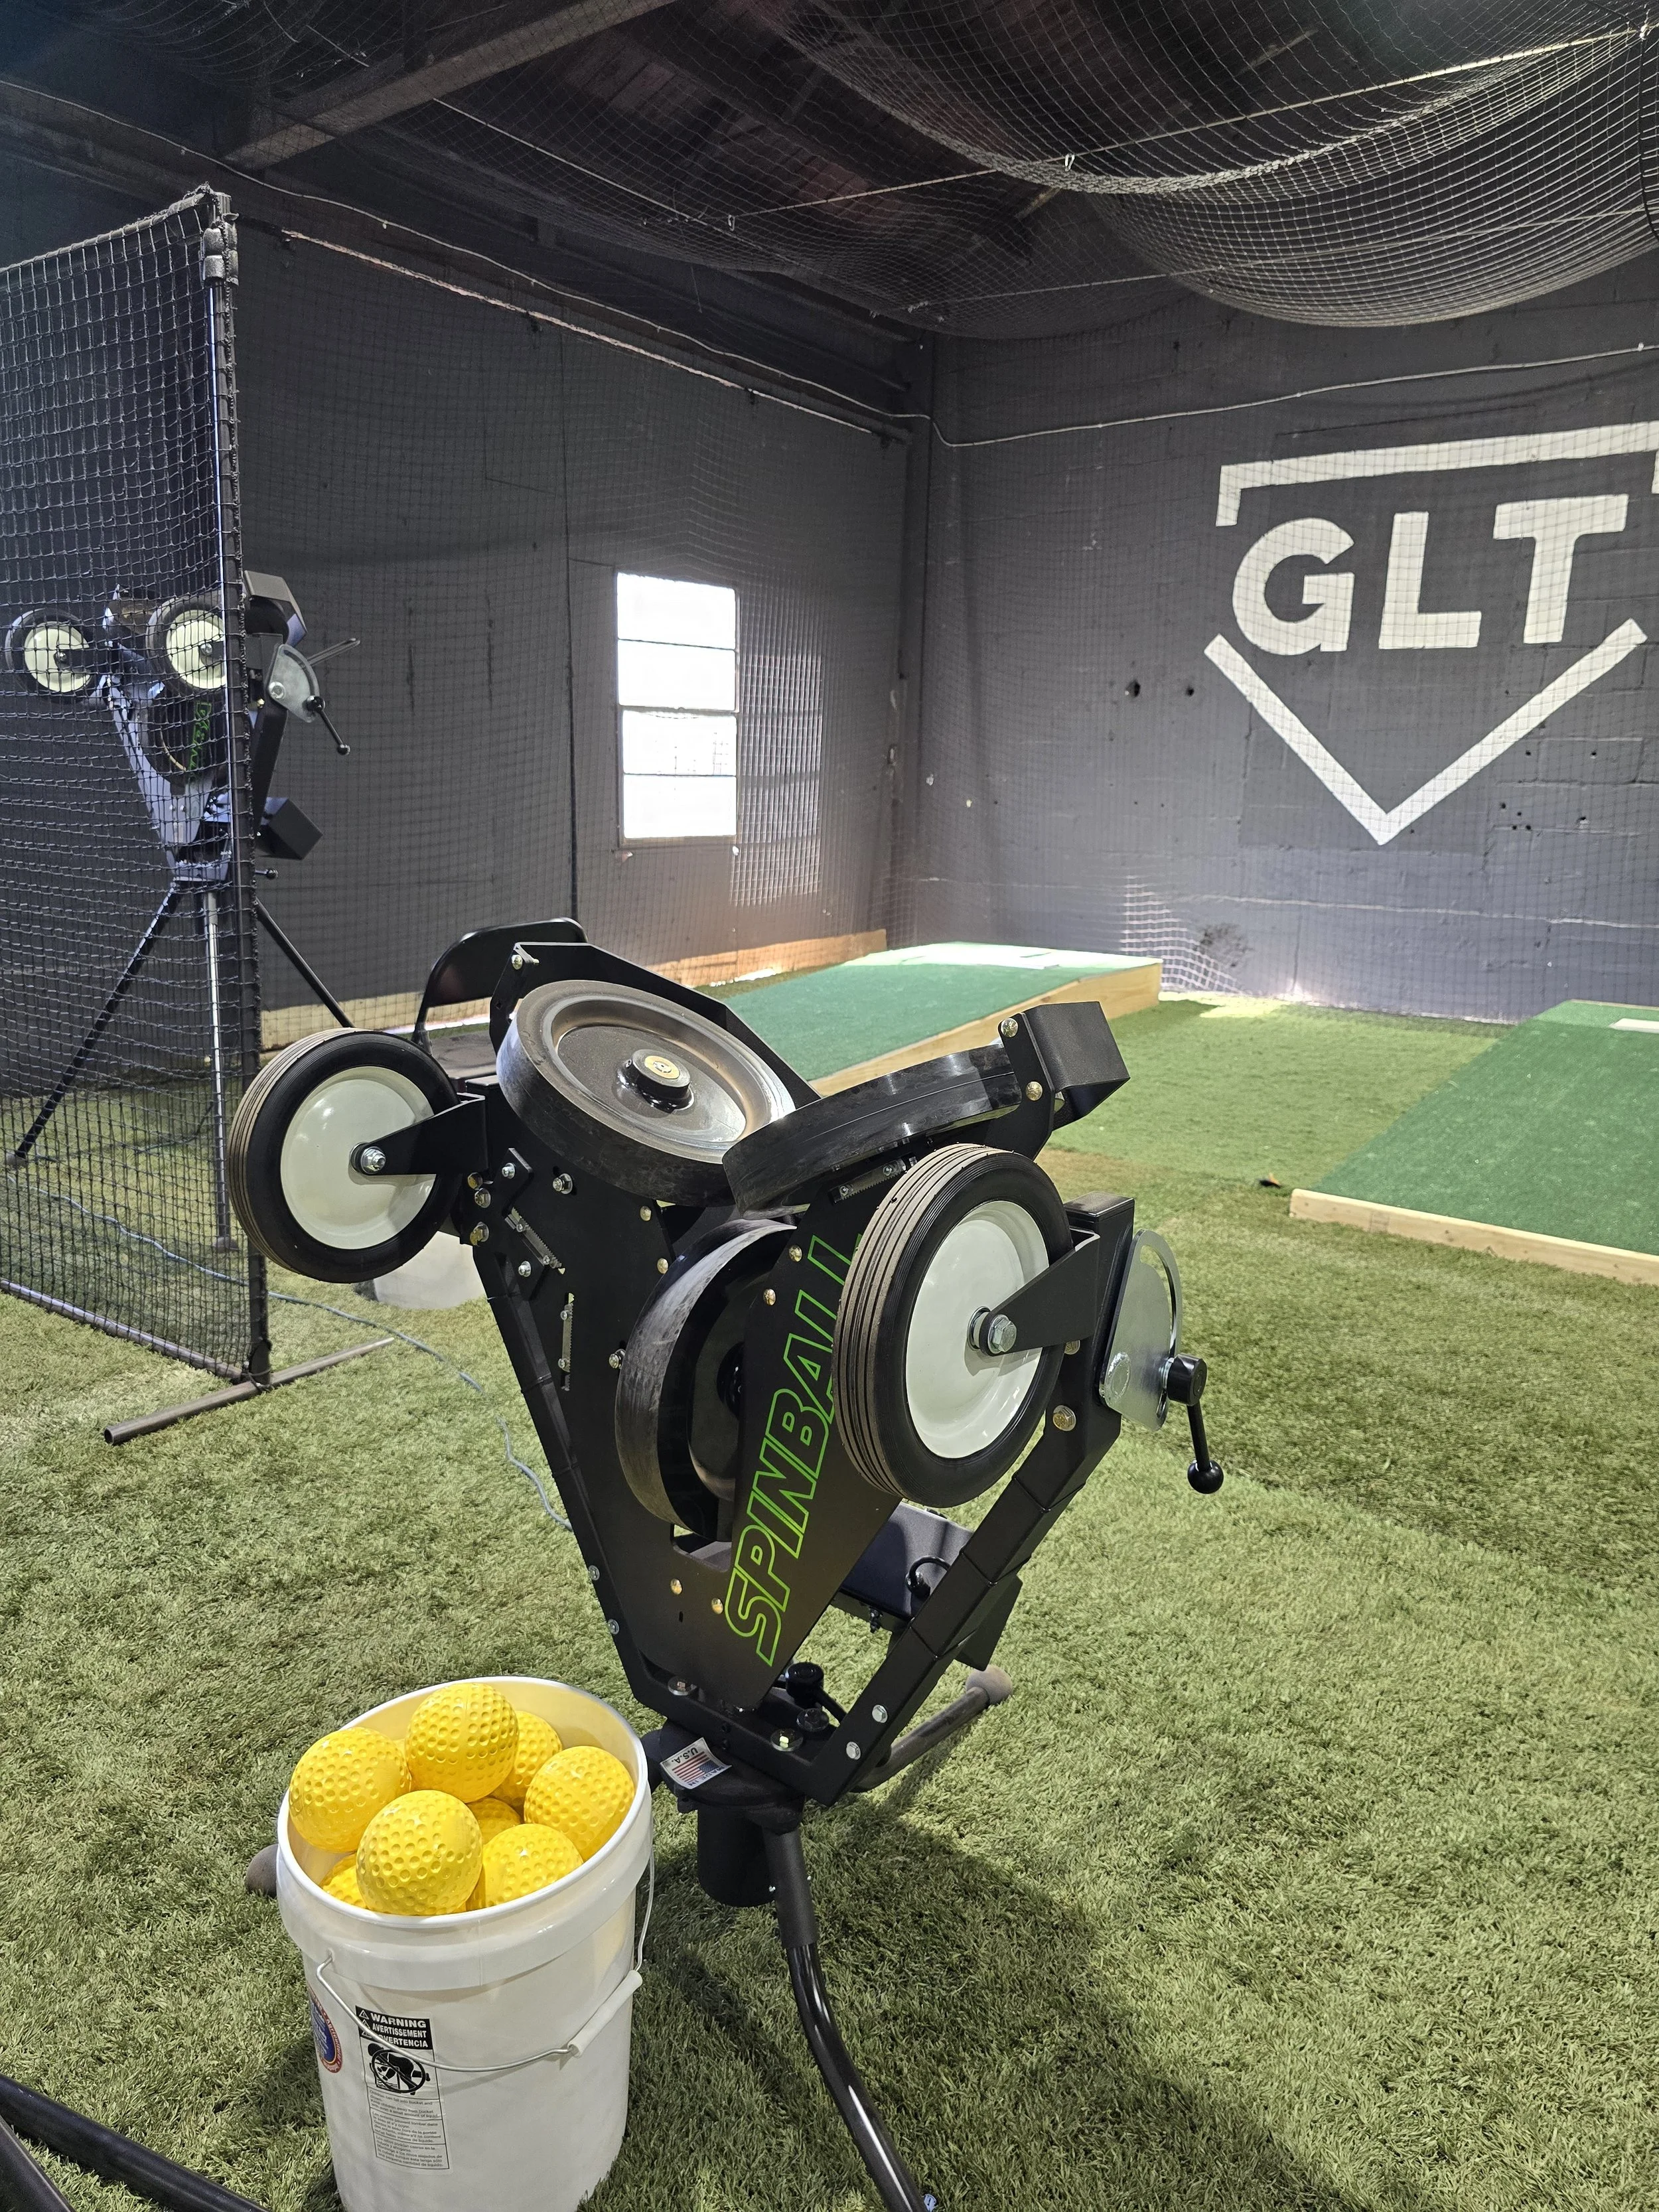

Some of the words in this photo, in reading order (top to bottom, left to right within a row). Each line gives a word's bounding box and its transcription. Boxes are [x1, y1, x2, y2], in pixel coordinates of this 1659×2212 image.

[1232, 494, 1628, 656] GLT
[672, 1747, 698, 1763] U.S.A.
[370, 2013, 427, 2028] WARNING
[372, 2023, 427, 2038] AVERTISSEMENT
[378, 2034, 428, 2047] VERTENCIA
